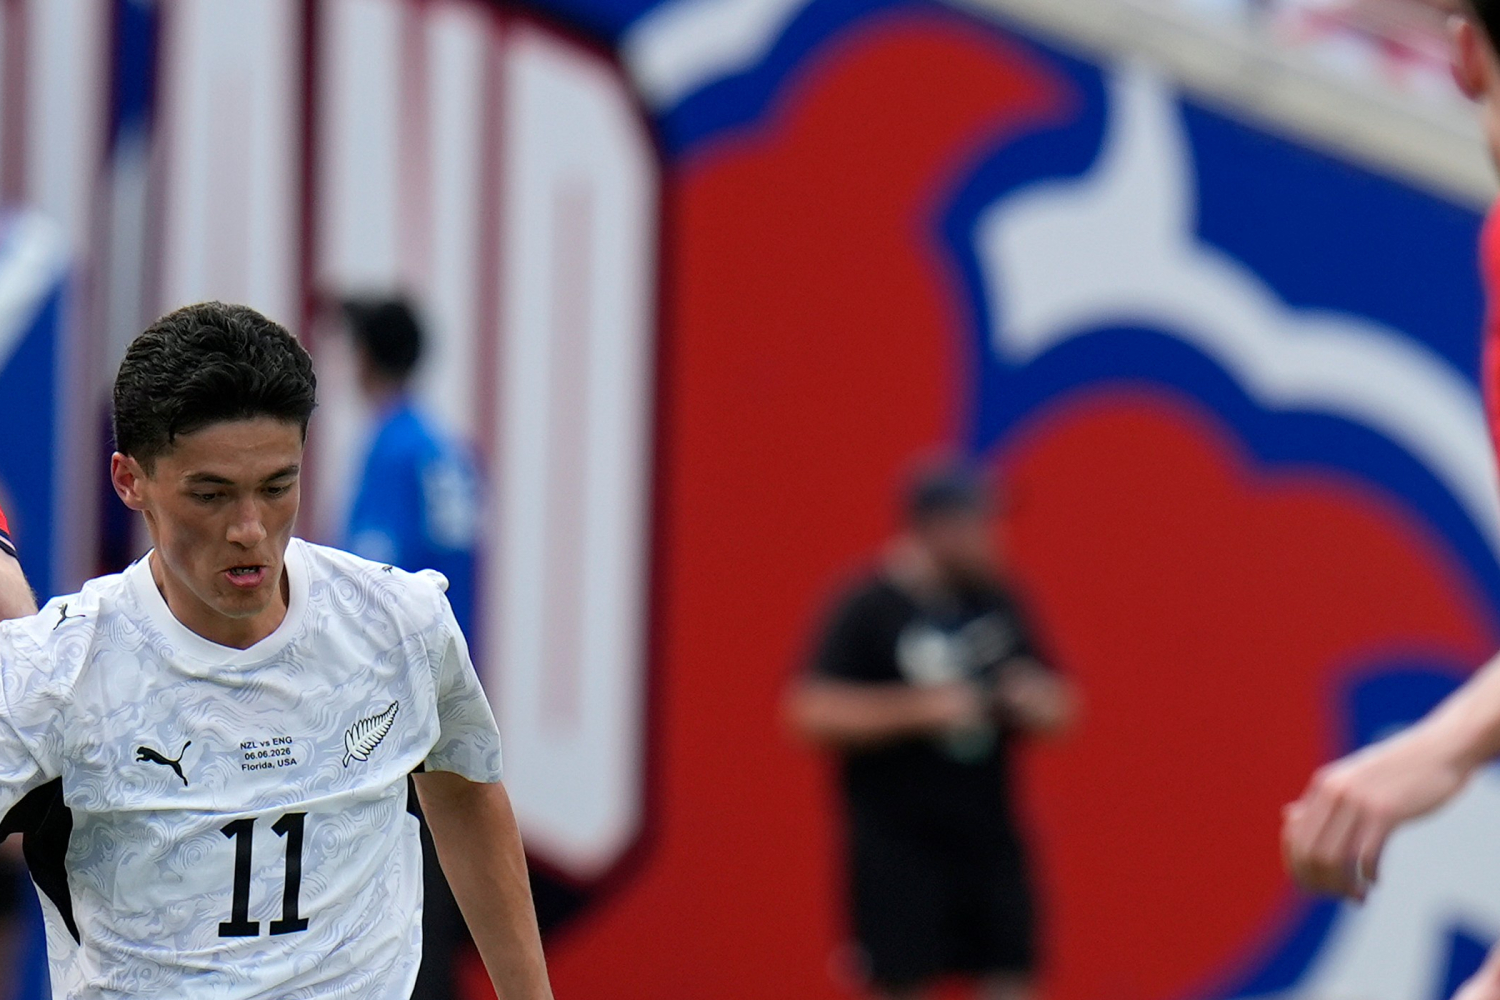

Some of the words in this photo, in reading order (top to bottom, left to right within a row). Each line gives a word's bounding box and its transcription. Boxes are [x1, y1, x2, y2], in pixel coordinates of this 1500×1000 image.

[240, 741, 258, 750] NZL
[272, 736, 293, 745] ENG
[244, 747, 291, 760] 06.06.2026
[241, 761, 275, 771] Florida,
[277, 758, 297, 767] USA
[218, 812, 309, 937] 11
